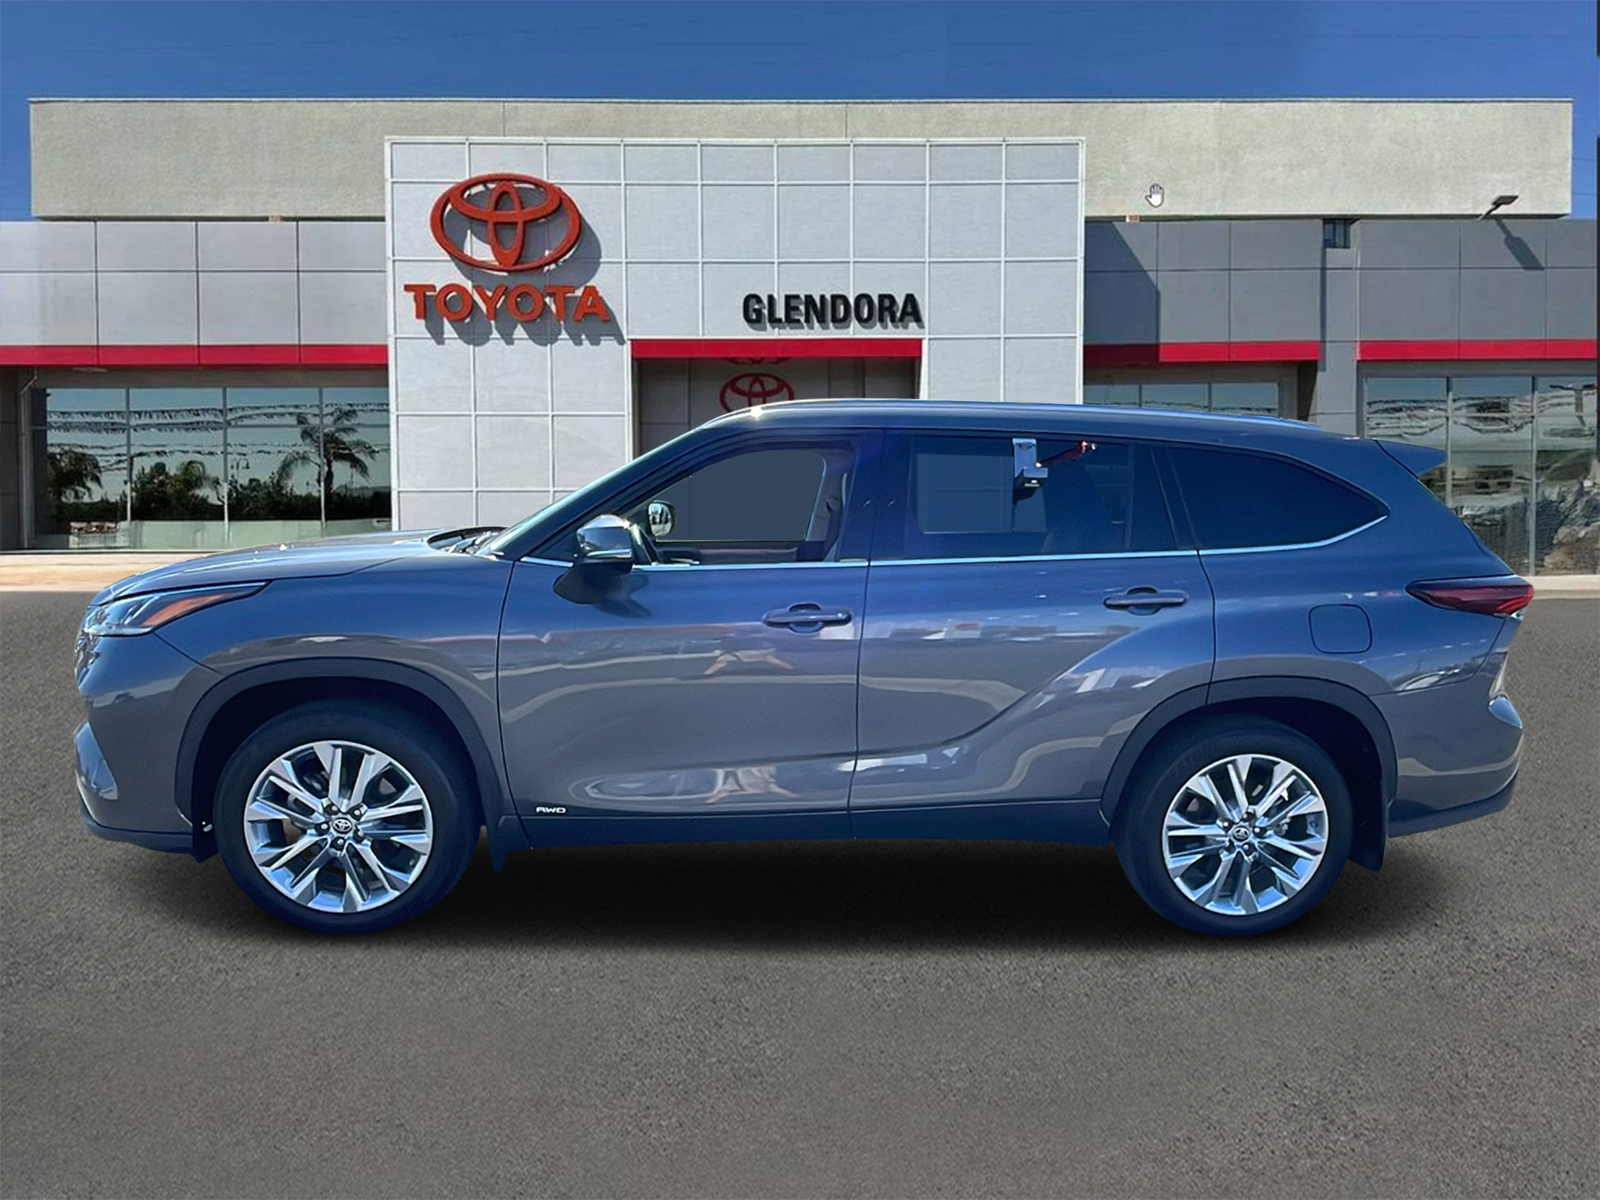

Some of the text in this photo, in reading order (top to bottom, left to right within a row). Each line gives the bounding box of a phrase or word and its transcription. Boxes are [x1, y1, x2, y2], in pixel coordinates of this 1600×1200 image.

[404, 283, 610, 322] TOYOTA
[743, 293, 922, 324] GLENDORA
[535, 806, 567, 814] AWD
